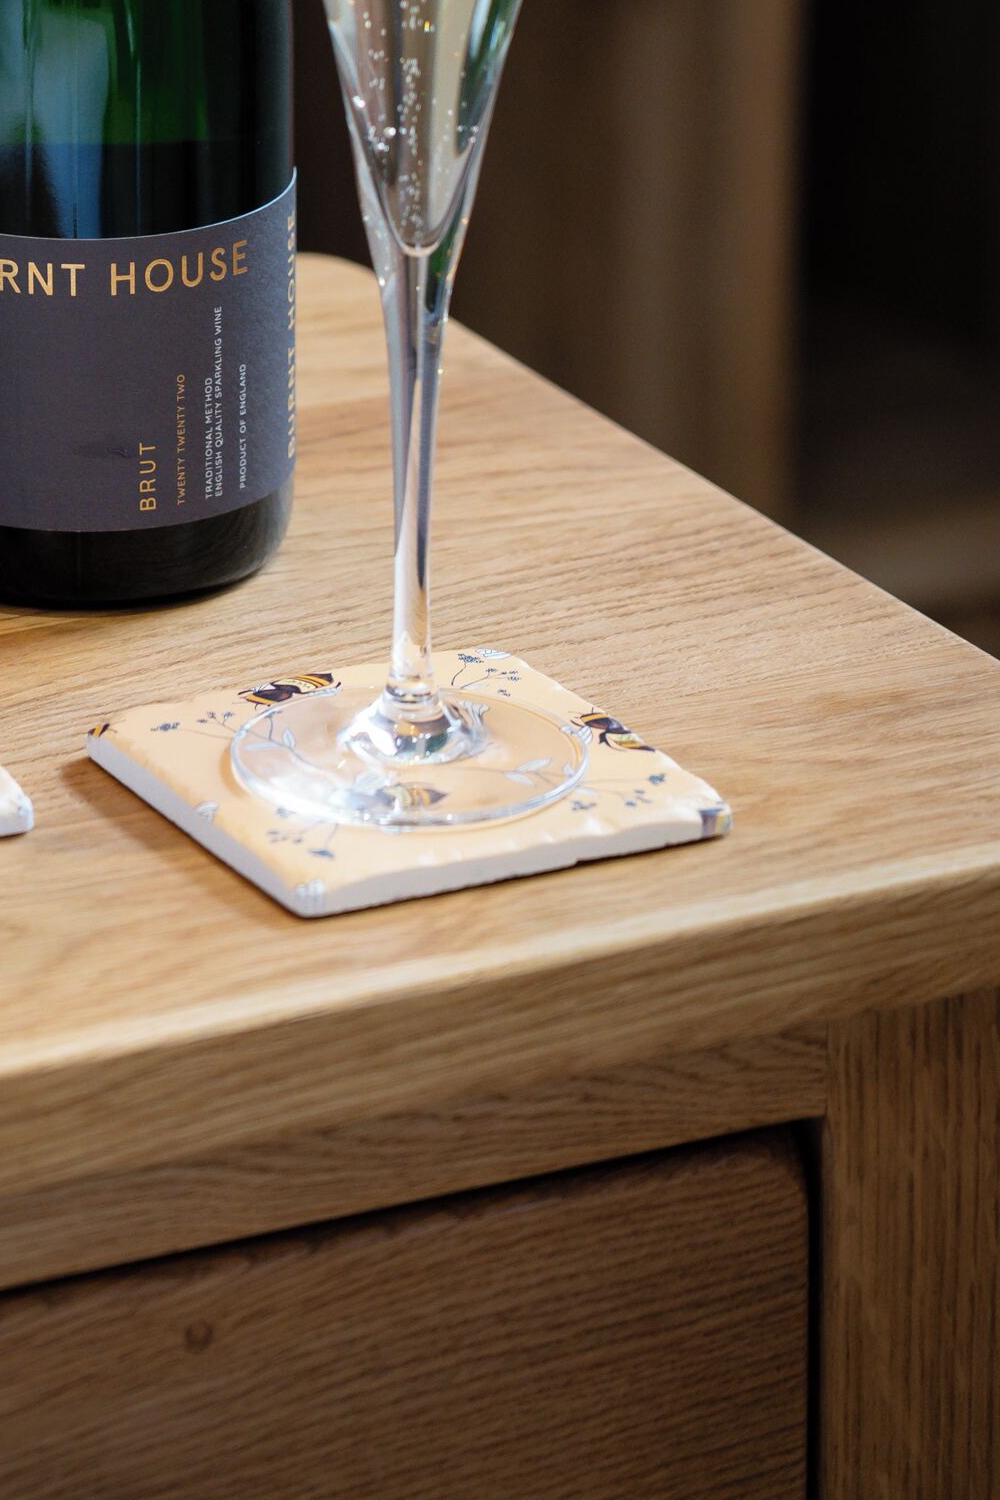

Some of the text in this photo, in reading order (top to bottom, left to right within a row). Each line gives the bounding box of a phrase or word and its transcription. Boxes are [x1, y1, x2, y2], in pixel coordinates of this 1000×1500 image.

[110, 239, 248, 296] HOUSE
[176, 374, 186, 506] TWENTY TWENTY TWO
[204, 377, 213, 500] TRADITIONAL METHOD
[214, 305, 223, 497] ENGLISH QUALITY SPARKLING WINE
[239, 364, 247, 490] PRODUCT OF ENGLAND
[139, 442, 157, 511] BRUT
